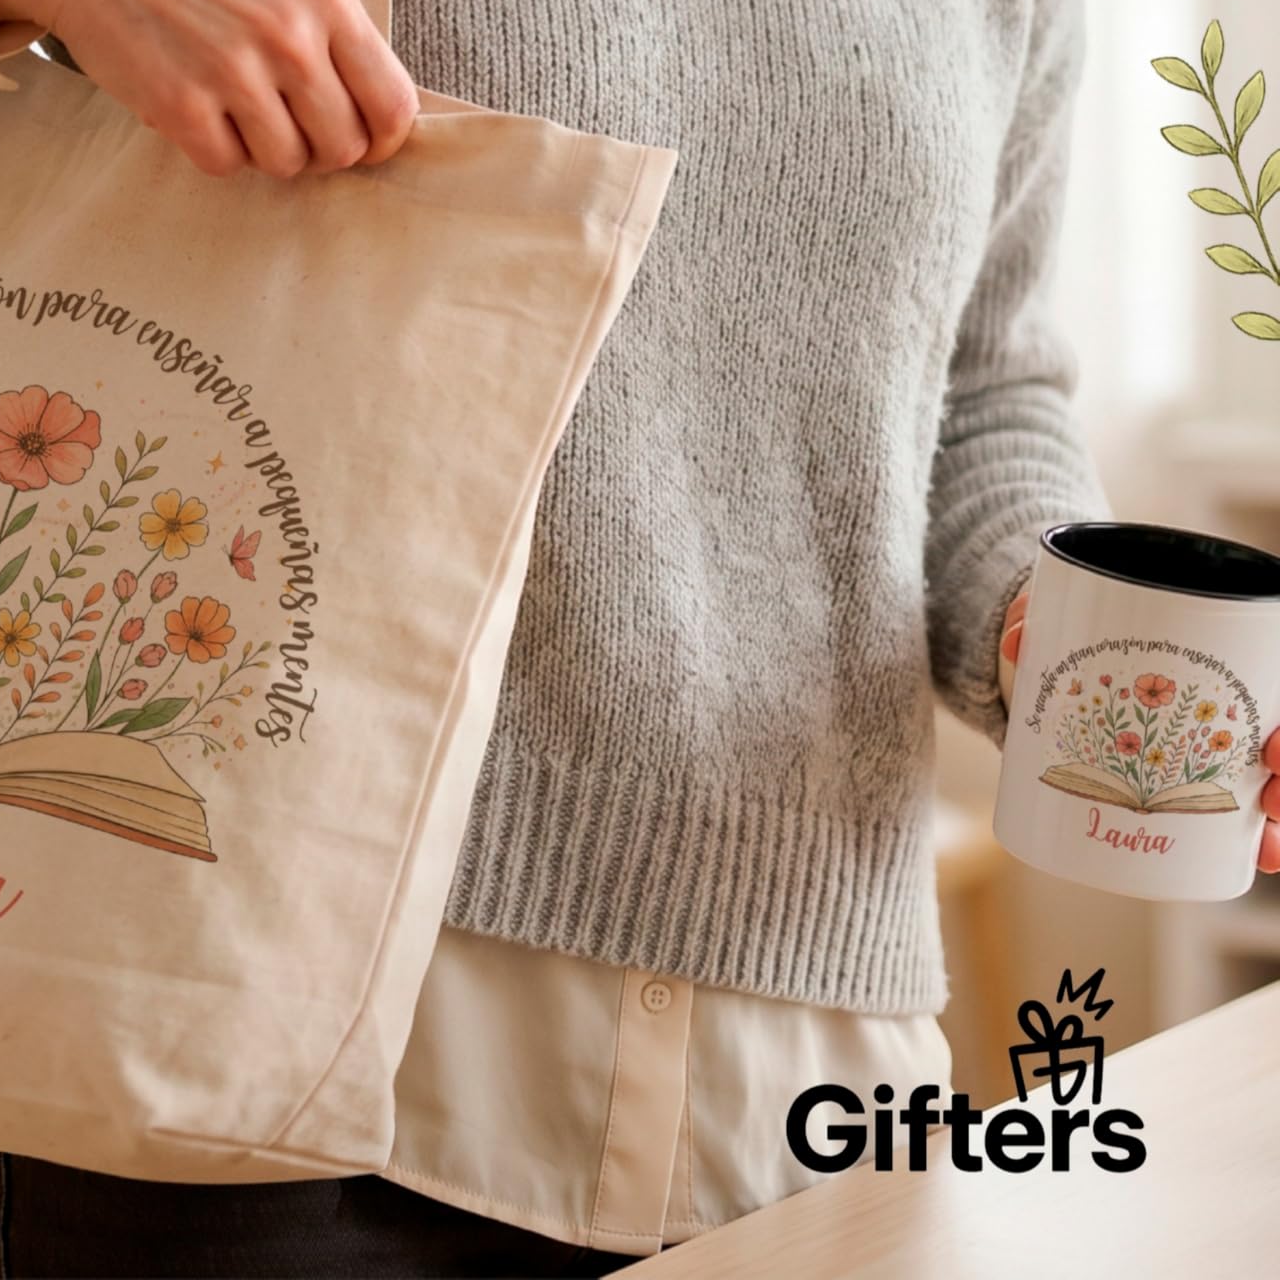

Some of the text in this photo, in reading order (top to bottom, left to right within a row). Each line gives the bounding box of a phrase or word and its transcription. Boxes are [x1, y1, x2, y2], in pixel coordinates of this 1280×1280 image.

[32, 288, 139, 336] para
[136, 319, 254, 421] enseñar
[244, 419, 273, 449] a
[244, 450, 320, 615] pequeñas
[1146, 639, 1181, 655] para
[255, 620, 319, 748] mentes
[1086, 807, 1176, 855] Laura
